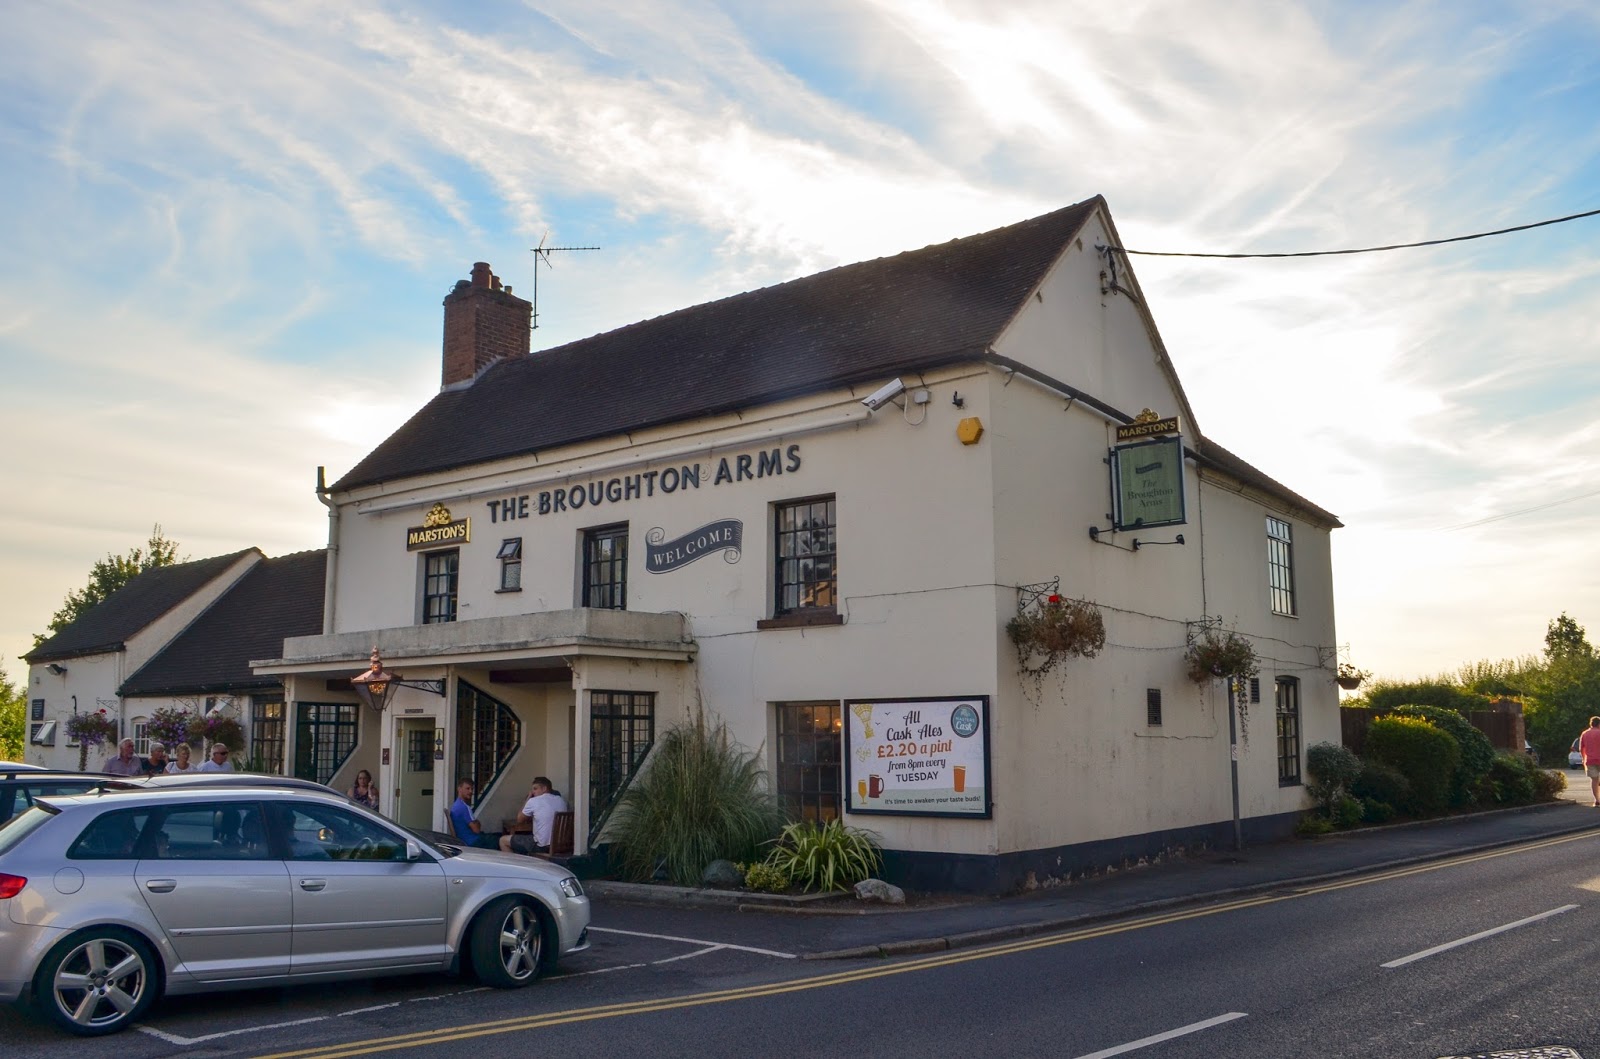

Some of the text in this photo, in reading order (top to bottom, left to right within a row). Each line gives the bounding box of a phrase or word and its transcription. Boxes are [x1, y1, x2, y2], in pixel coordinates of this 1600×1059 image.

[1119, 420, 1175, 438] MARSTON'S
[487, 445, 801, 523] THE BROUGHTON ARMS
[1128, 488, 1173, 500] Broughton
[409, 524, 465, 544] MARSTON'S
[653, 527, 733, 566] WELCOME
[903, 710, 920, 726] All
[956, 721, 972, 731] Cask
[886, 724, 943, 741] Cask Ales
[877, 739, 952, 758] £2.20 a pint
[887, 759, 946, 773] from 8pm every
[896, 771, 938, 782] TUESDAY
